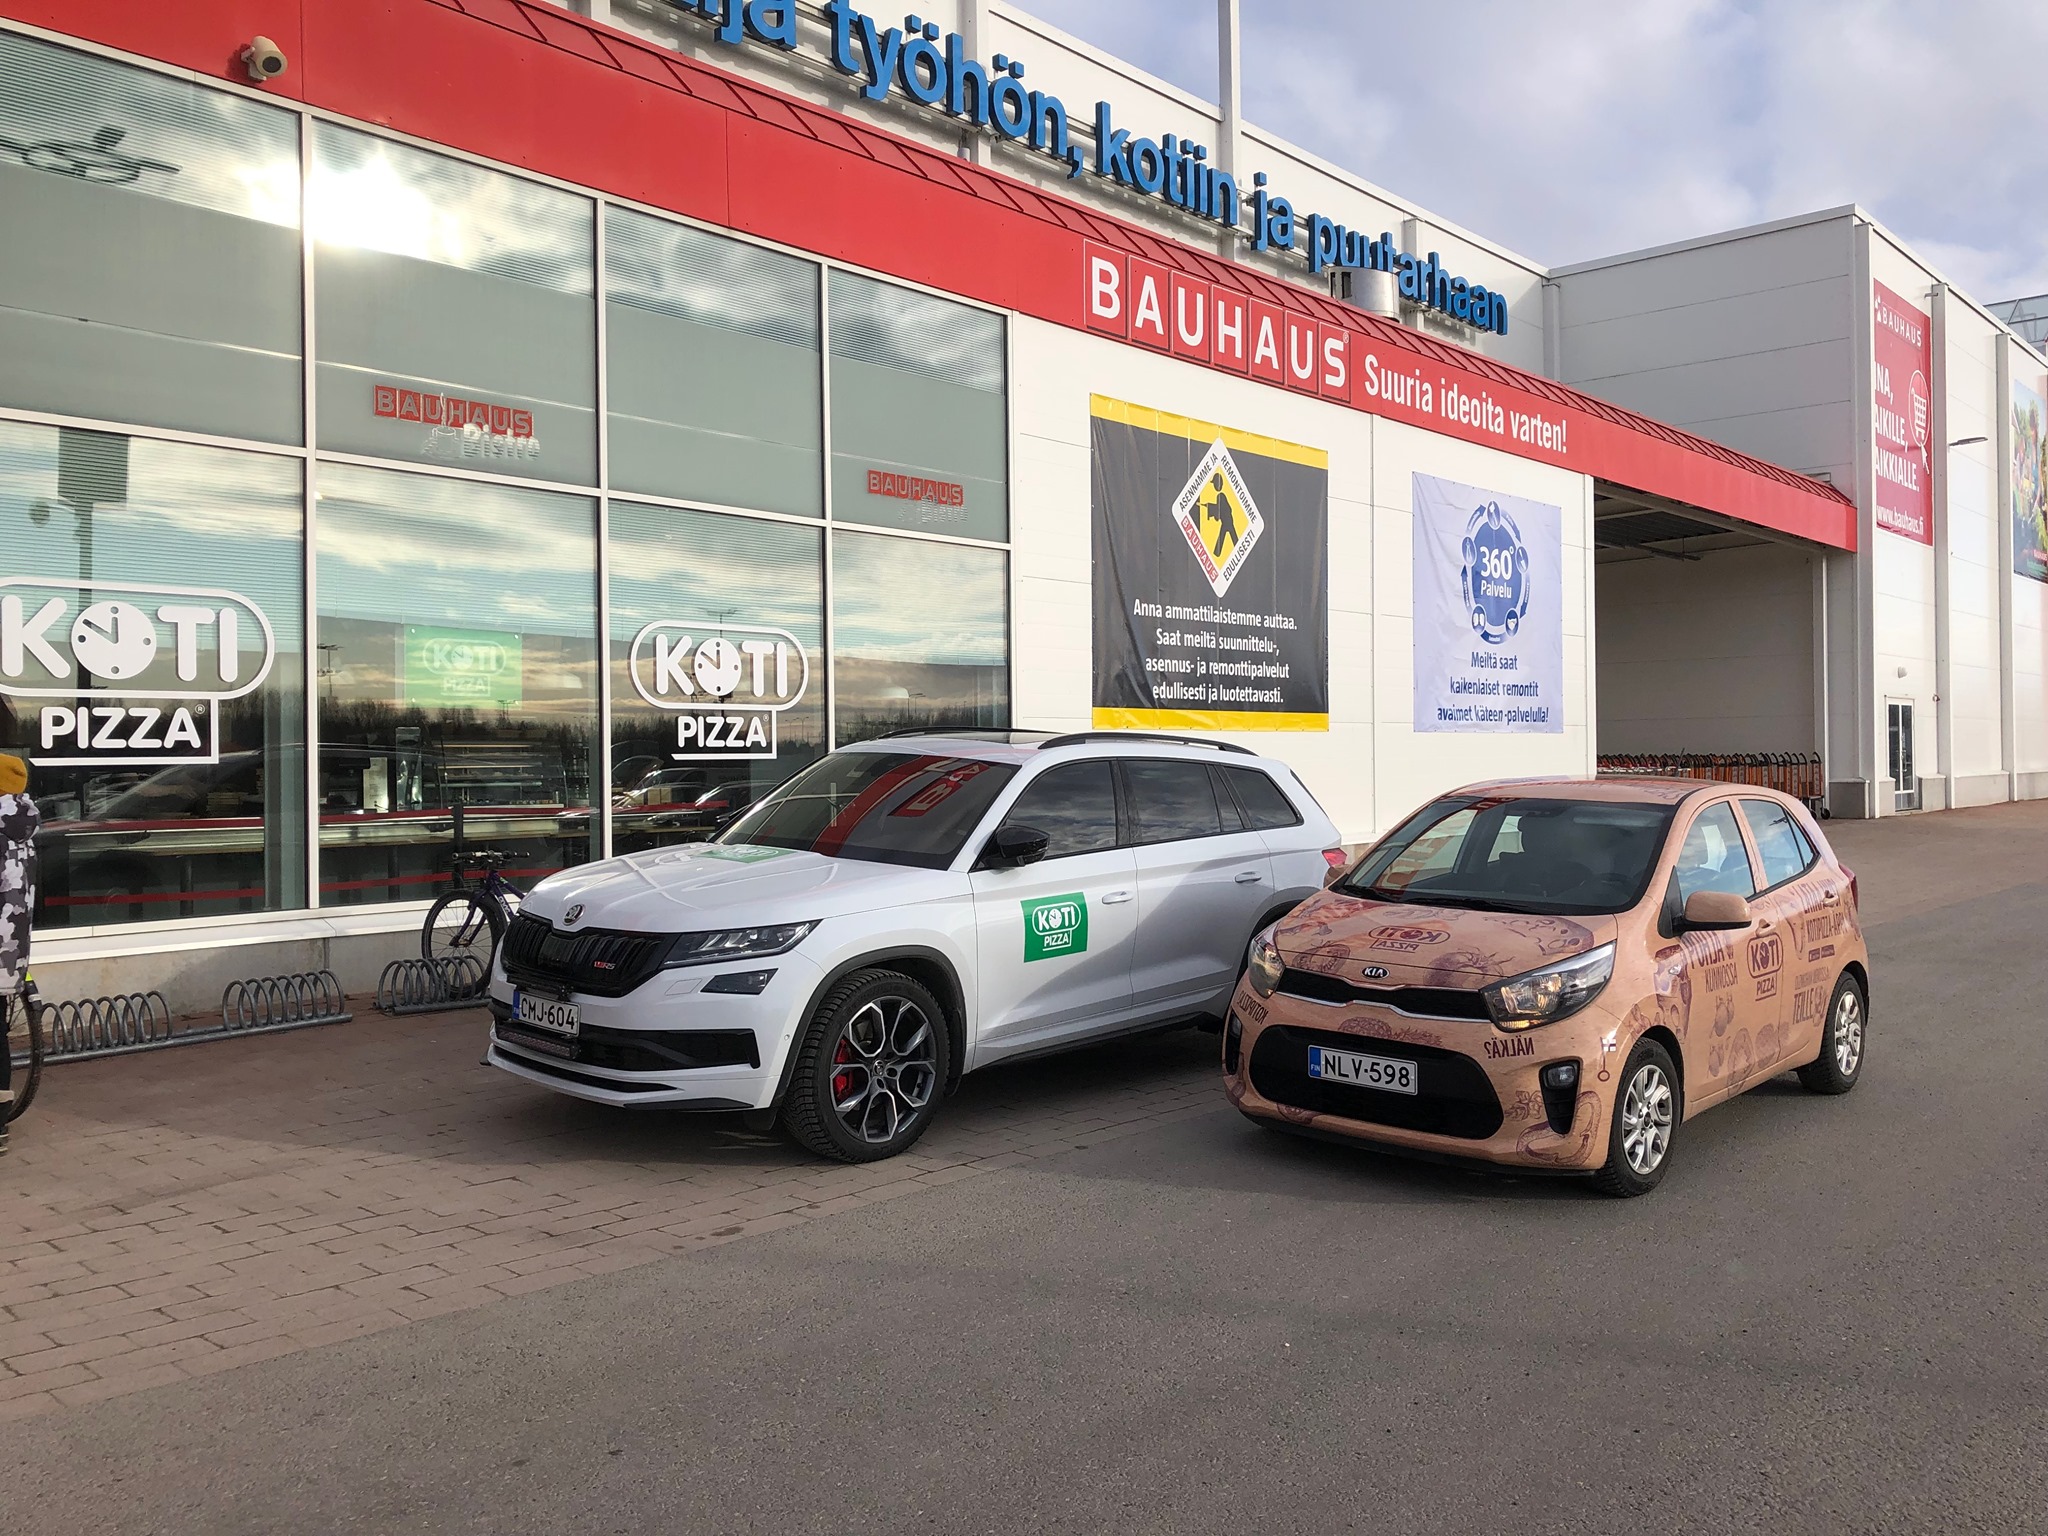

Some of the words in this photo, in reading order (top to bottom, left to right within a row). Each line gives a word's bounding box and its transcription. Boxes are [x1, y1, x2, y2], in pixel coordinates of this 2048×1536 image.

[825, 0, 1083, 179] työhön,
[1095, 101, 1237, 227] kotiin
[1250, 172, 1294, 251] ja
[1308, 213, 1508, 336] puutarhaan
[1882, 306, 1922, 347] BAUHAUS
[377, 389, 532, 434] BAUHAUS
[1365, 354, 1433, 413] Suuria
[1440, 378, 1504, 435] ideoita
[1510, 410, 1567, 454] varten!
[1874, 404, 1908, 453] AIKILLE,
[1874, 446, 1920, 492] AIKKIALLE.
[869, 473, 963, 504] BAUHAUS
[1179, 462, 1213, 512] ASENNAMME
[1210, 452, 1219, 469] JA
[1220, 455, 1258, 524] REMONTOIMME
[1182, 517, 1218, 581] BAUHAUS
[1223, 529, 1255, 581] EDULLISESTI
[1480, 580, 1512, 598] Palvelu
[1133, 598, 1162, 618] Anna
[1165, 605, 1262, 627] ammattilaistemme
[1264, 614, 1298, 630] auttaa.
[1, 595, 238, 683] KOTI
[1156, 628, 1181, 646] Saat
[1184, 631, 1216, 648] meiltä
[1219, 634, 1279, 656] suunnittelu-,
[433, 642, 498, 671] KOTI
[655, 632, 788, 698] KOTI
[1146, 657, 1194, 674] asennus-
[1197, 657, 1206, 677] ja
[1209, 660, 1290, 680] remonttipalvelut
[1470, 651, 1497, 669] Meiltä
[1499, 655, 1518, 671] saat
[1152, 681, 1206, 701] edullisesti
[1208, 684, 1217, 704] ja
[1219, 685, 1284, 703] luotettavasti.
[1450, 676, 1500, 696] kaikenlaiset
[1502, 681, 1539, 697] remontit
[1437, 703, 1472, 722] avaimet
[1474, 705, 1503, 722] käteen
[1037, 905, 1076, 931] KOTI
[1043, 932, 1069, 947] PIZZA
[1751, 938, 1779, 973] KOTI
[1364, 967, 1384, 978] KIA
[1756, 976, 1775, 996] PIZZA
[520, 997, 575, 1030] CMJ-604
[1311, 1064, 1320, 1072] FIN
[1324, 1053, 1411, 1088] NLV-598
